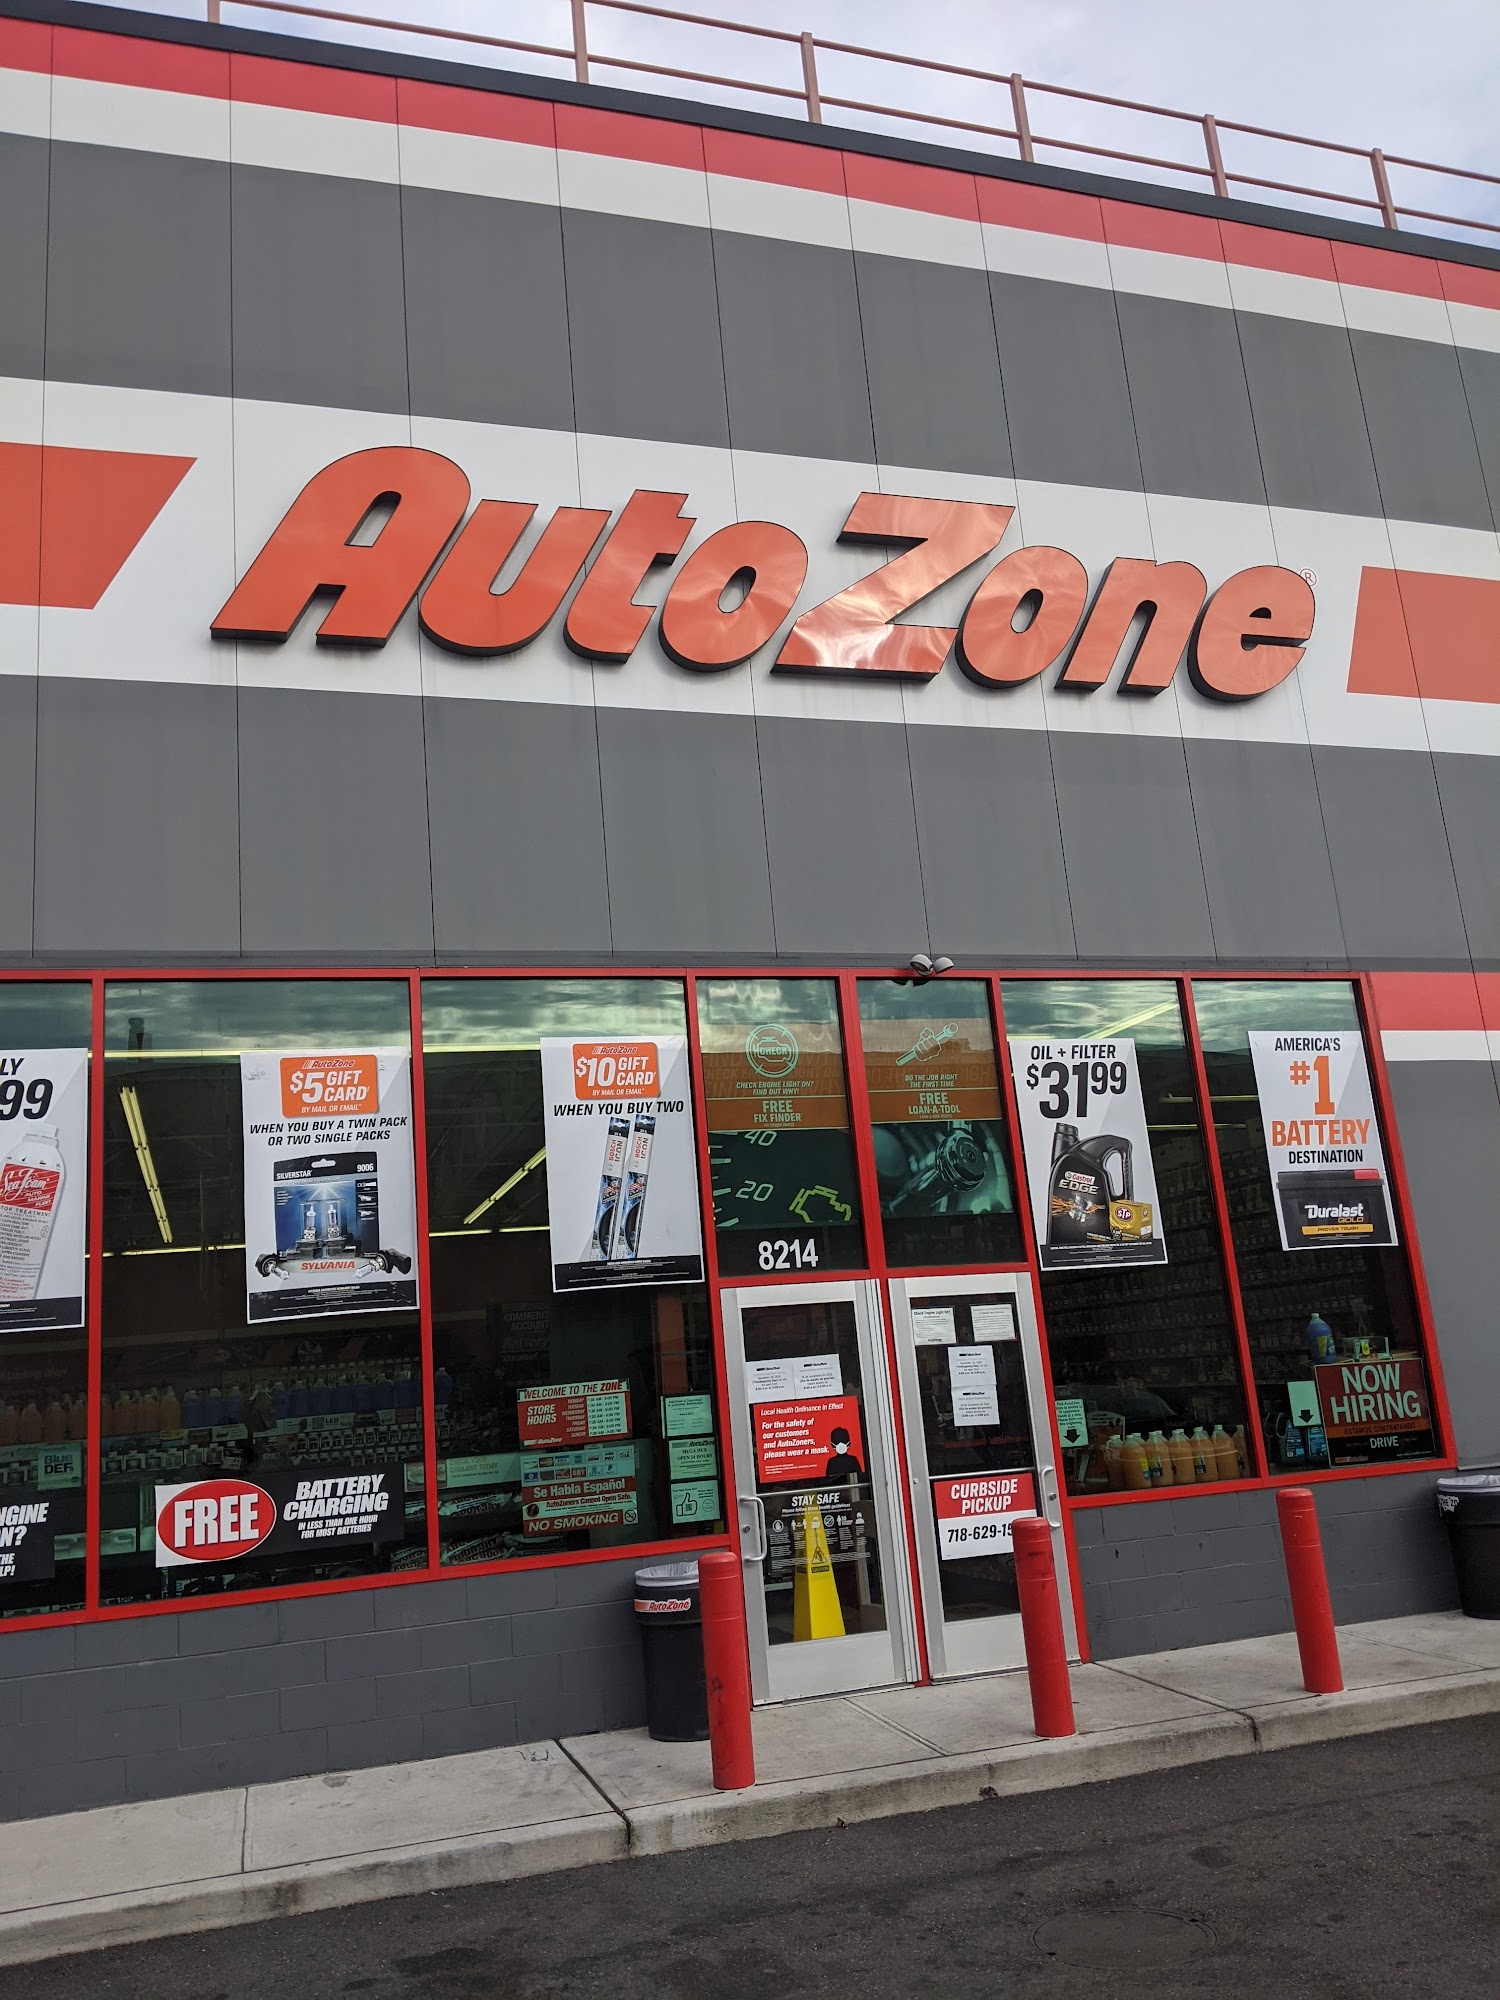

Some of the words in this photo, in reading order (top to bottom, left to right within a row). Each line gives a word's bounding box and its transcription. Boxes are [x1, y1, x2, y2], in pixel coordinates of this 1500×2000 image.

[760, 1046, 787, 1056] CHECK
[1274, 1037, 1341, 1051] AMERICA'S
[1031, 1045, 1053, 1060] OIL
[1057, 1048, 1066, 1057] +
[1071, 1045, 1116, 1059] FILTER
[576, 1056, 616, 1087] $10
[618, 1057, 649, 1071] GIFT
[290, 1070, 325, 1104] $5
[326, 1070, 362, 1086] GIFT
[1290, 1055, 1335, 1115] #1
[919, 1092, 948, 1104] FREE
[312, 1105, 327, 1113] MAIL
[553, 1104, 593, 1117] WHEN
[598, 1103, 623, 1115] YOU
[627, 1102, 653, 1114] BUY
[656, 1101, 684, 1112] TWO
[762, 1100, 793, 1113] FREE
[908, 1105, 961, 1114] LOAN-A-TOOL
[250, 1123, 284, 1134] WHEN
[287, 1122, 309, 1132] YOU
[312, 1121, 334, 1131] BUY
[337, 1120, 344, 1130] A
[349, 1118, 376, 1129] TWIN
[379, 1117, 408, 1127] PACK
[754, 1114, 768, 1122] FIX
[268, 1136, 282, 1146] OR
[287, 1135, 311, 1145] TWO
[314, 1133, 352, 1143] SINGLE
[356, 1130, 391, 1141] PACKS
[744, 1130, 777, 1146] 40
[1272, 1119, 1370, 1147] BATTERY
[608, 1140, 617, 1161] BOSCH
[615, 1140, 623, 1162] ICON
[641, 1137, 649, 1159] ICON
[1289, 1149, 1363, 1164] DESTINATION
[357, 1163, 374, 1173] 9006
[1072, 1173, 1093, 1184] Castrol
[735, 1180, 774, 1201] 20
[1058, 1179, 1099, 1195] EDGE
[1117, 1208, 1131, 1219] STP
[1304, 1203, 1364, 1219] Duralast
[758, 1238, 819, 1271] 8214
[301, 1261, 355, 1270] SYLVANIA
[1341, 1363, 1400, 1394] NOW
[524, 1388, 566, 1400] WELCOME
[569, 1386, 580, 1395] TO
[582, 1384, 598, 1393] THE
[600, 1381, 622, 1391] ZONE
[527, 1404, 556, 1415] STORE
[760, 1408, 775, 1416] Local
[776, 1406, 793, 1414] Health
[795, 1405, 821, 1413] Ordinance
[1330, 1390, 1422, 1424] HIRING
[527, 1414, 557, 1425] HOURS
[762, 1421, 773, 1429] For
[773, 1420, 784, 1428] the
[786, 1419, 806, 1428] safety
[807, 1417, 815, 1425] of
[775, 1429, 809, 1438] customers
[1344, 1426, 1372, 1435] ESTAMOS
[1373, 1422, 1416, 1433] CONTRATANDO
[763, 1441, 776, 1449] and
[777, 1438, 816, 1448] AutoZoners,
[1370, 1436, 1399, 1448] DRIVE
[44, 1454, 73, 1464] Blue
[764, 1450, 786, 1460] please
[811, 1446, 830, 1454] mask.
[479, 1463, 498, 1471] TODAY
[295, 1474, 385, 1500] BATTERY
[533, 1487, 548, 1498] Se
[550, 1483, 581, 1497] Habla
[583, 1478, 625, 1494] Español
[951, 1479, 1018, 1500] CURBSIDE
[283, 1492, 389, 1521] CHARGING
[791, 1495, 815, 1507] STAY
[816, 1492, 840, 1505] SAFE
[961, 1495, 1012, 1514] PICKUP
[174, 1493, 260, 1548] FREE
[298, 1522, 306, 1531] IN
[307, 1520, 323, 1530] LESS
[325, 1518, 343, 1528] THAN
[344, 1517, 358, 1526] ONE
[359, 1515, 378, 1525] HOUR
[528, 1521, 550, 1532] NO
[553, 1513, 619, 1529] SMOKING
[301, 1530, 314, 1539] FOR
[316, 1528, 335, 1538] MOST
[337, 1524, 372, 1536] BATTERIES
[649, 1600, 689, 1611] AutoZone
